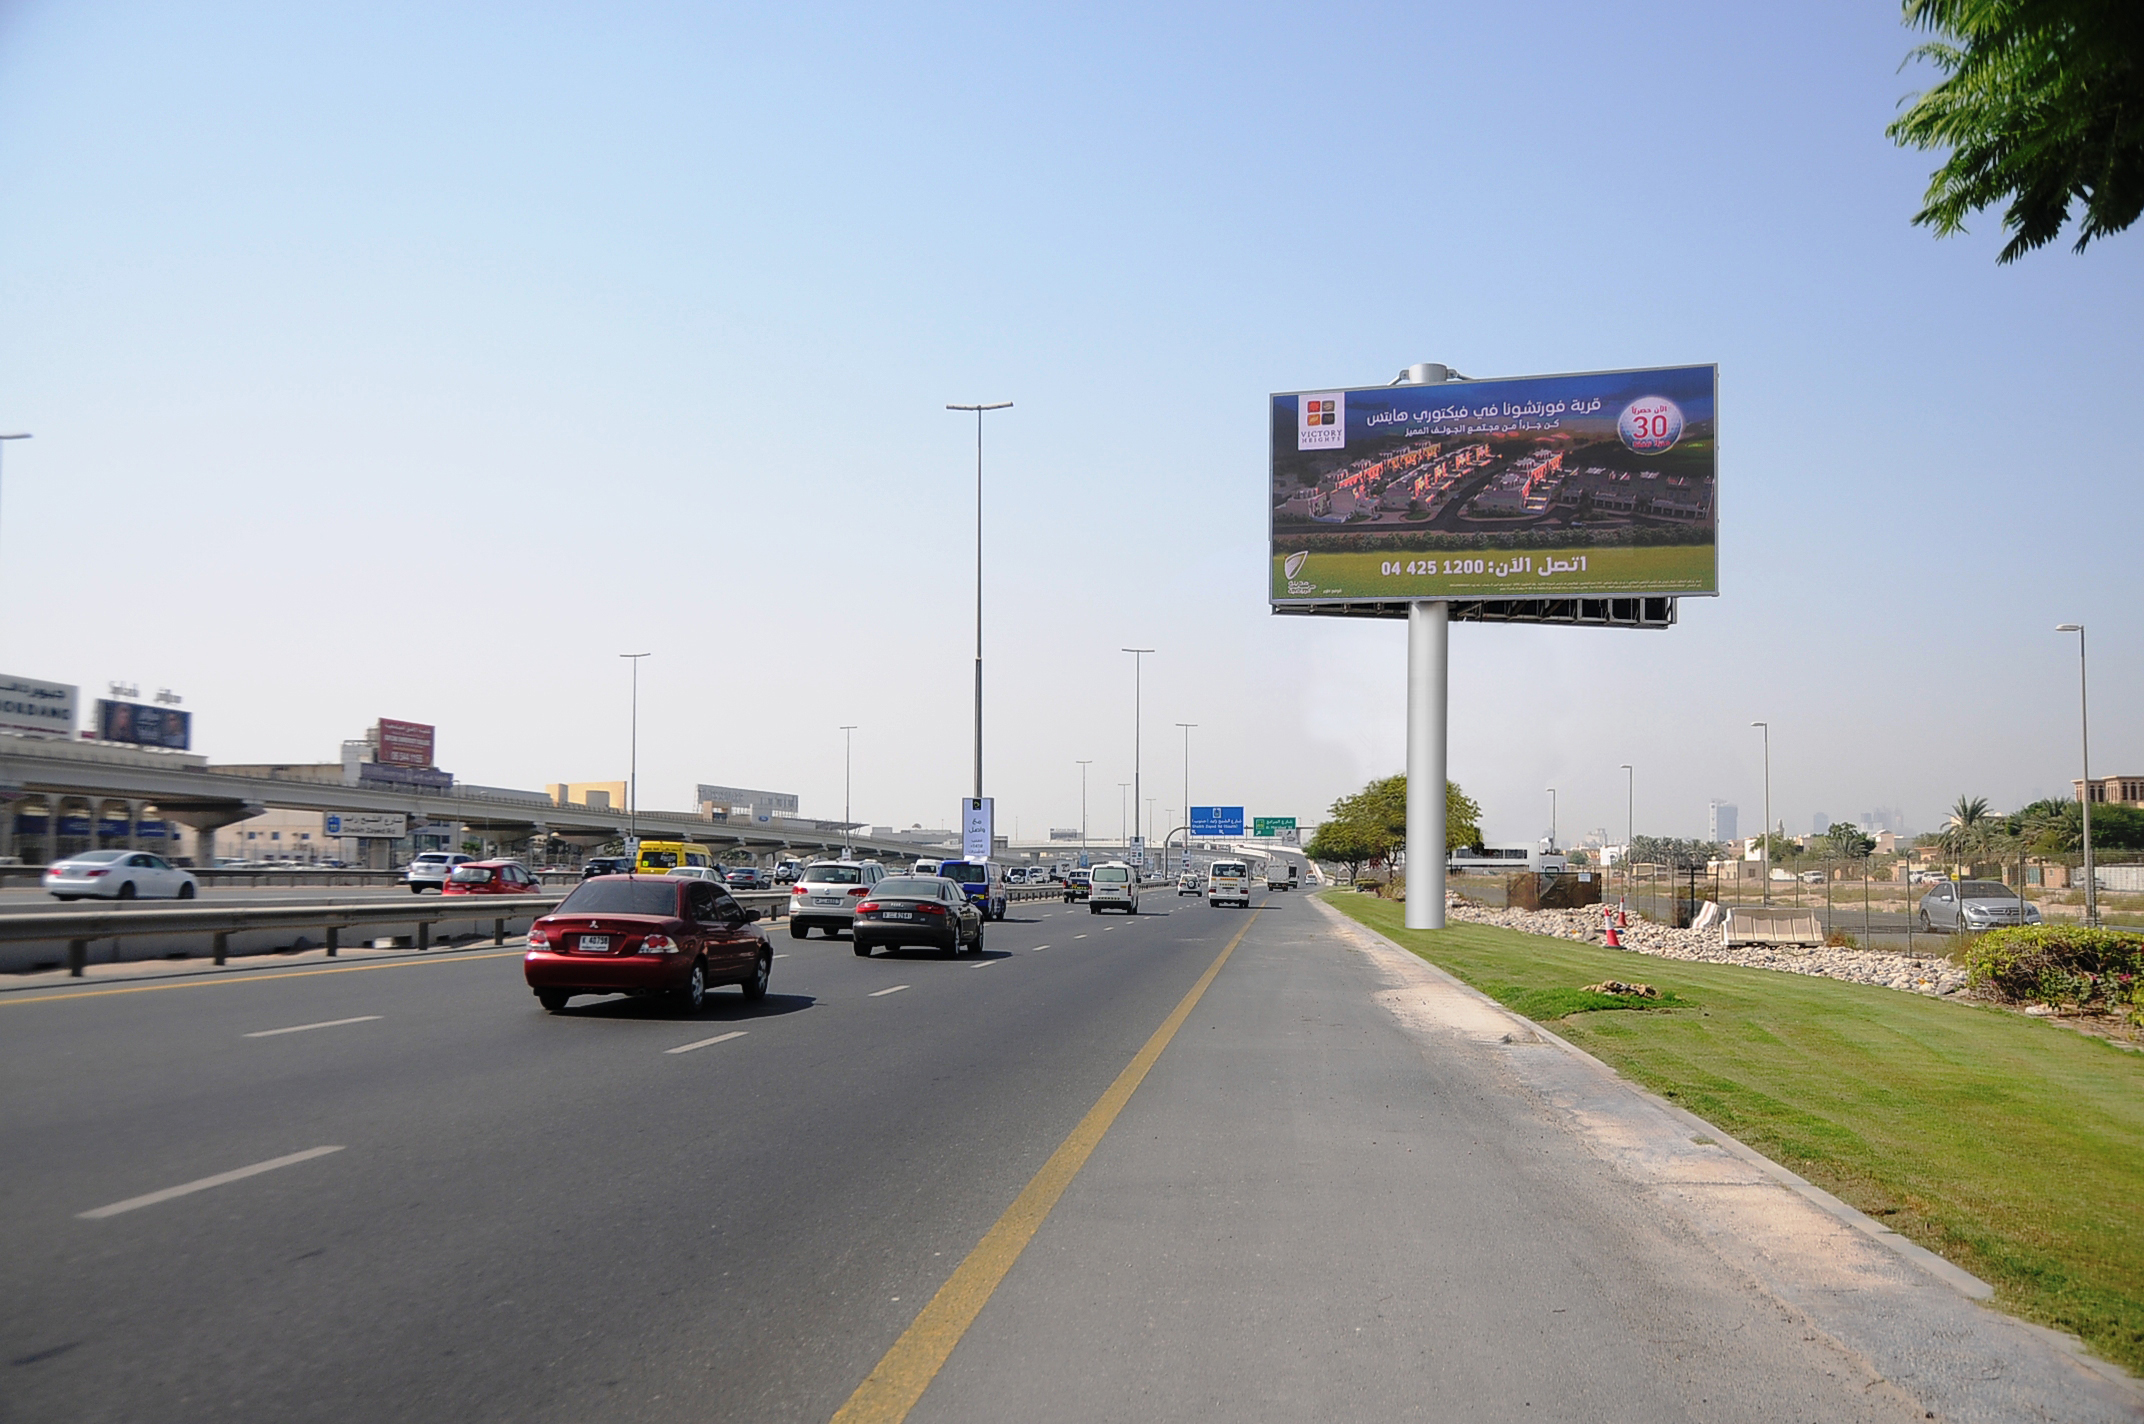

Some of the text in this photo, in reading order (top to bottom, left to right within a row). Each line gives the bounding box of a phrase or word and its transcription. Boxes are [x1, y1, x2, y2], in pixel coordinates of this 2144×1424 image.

[1366, 397, 1601, 427] قرية فورتشونا في فيكتوري هايتس
[1301, 429, 1342, 438] VICTORY
[1467, 423, 1500, 434] مجتمع
[1502, 422, 1516, 432] من
[1633, 415, 1667, 439] 30
[1302, 436, 1341, 444] HEIGHTS
[1381, 561, 1401, 576] 04
[1406, 560, 1437, 575] 425
[1443, 559, 1484, 575] 1200
[1537, 556, 1586, 577] اتصل
